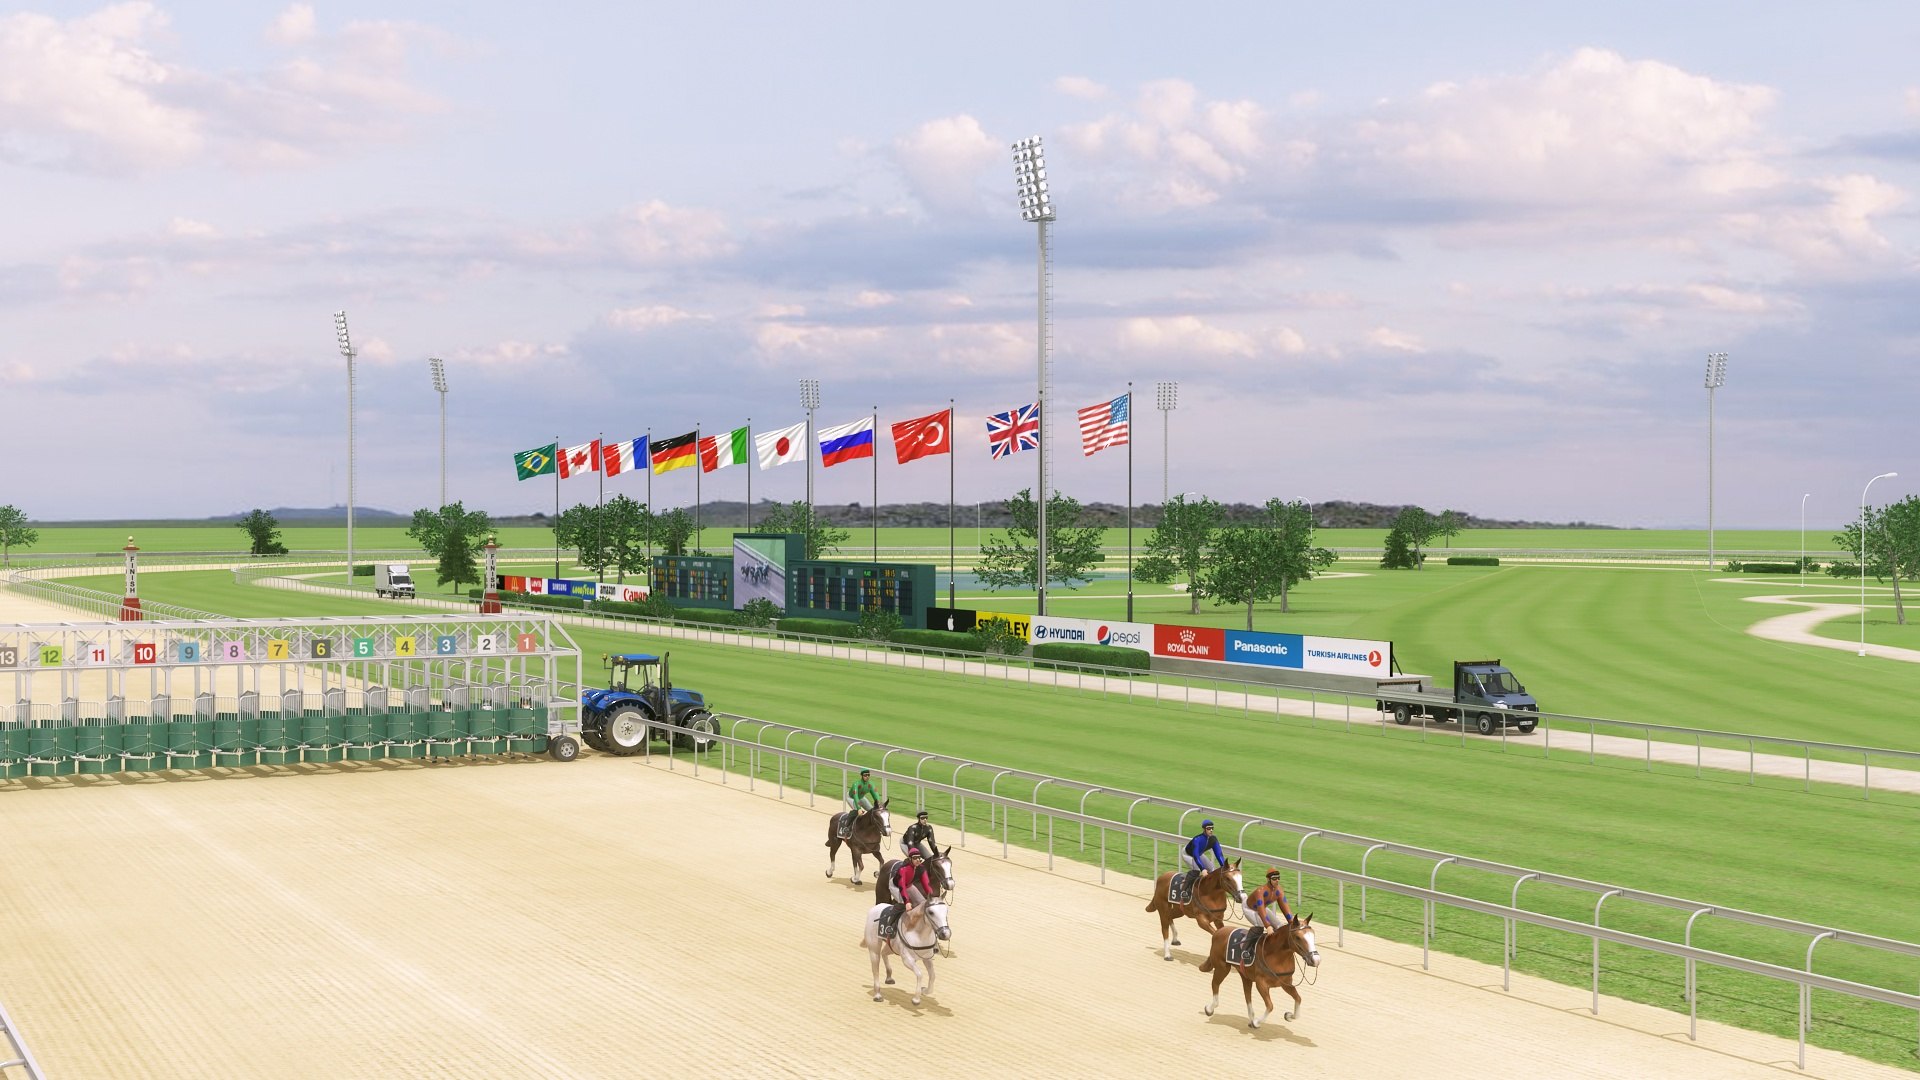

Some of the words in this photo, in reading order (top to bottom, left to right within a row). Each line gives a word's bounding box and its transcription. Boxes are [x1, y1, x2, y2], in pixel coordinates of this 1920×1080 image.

[572, 584, 595, 596] GOODYEAR
[978, 619, 1029, 637] STLEY
[1049, 627, 1085, 641] HYUNDAI
[482, 638, 491, 650] 2
[523, 637, 530, 649] 1
[1112, 631, 1141, 644] pepsi
[229, 645, 239, 658] 8
[273, 644, 283, 656] 7
[316, 643, 326, 656] 6
[358, 641, 368, 654] 5
[401, 640, 410, 653] 4
[442, 639, 451, 651] 3
[1167, 643, 1187, 653] ROYAL
[1188, 645, 1209, 655] CANIN
[1234, 640, 1287, 655] Panasonic
[0, 651, 15, 665] 13
[42, 650, 59, 664] 12
[92, 649, 105, 662] 11
[137, 647, 153, 661] 10
[184, 646, 194, 659] 9
[1308, 649, 1336, 659] TURKISH
[1337, 652, 1367, 662] AIRLINES
[1171, 890, 1177, 899] 5
[880, 924, 885, 935] 3
[1231, 948, 1235, 960] 1
